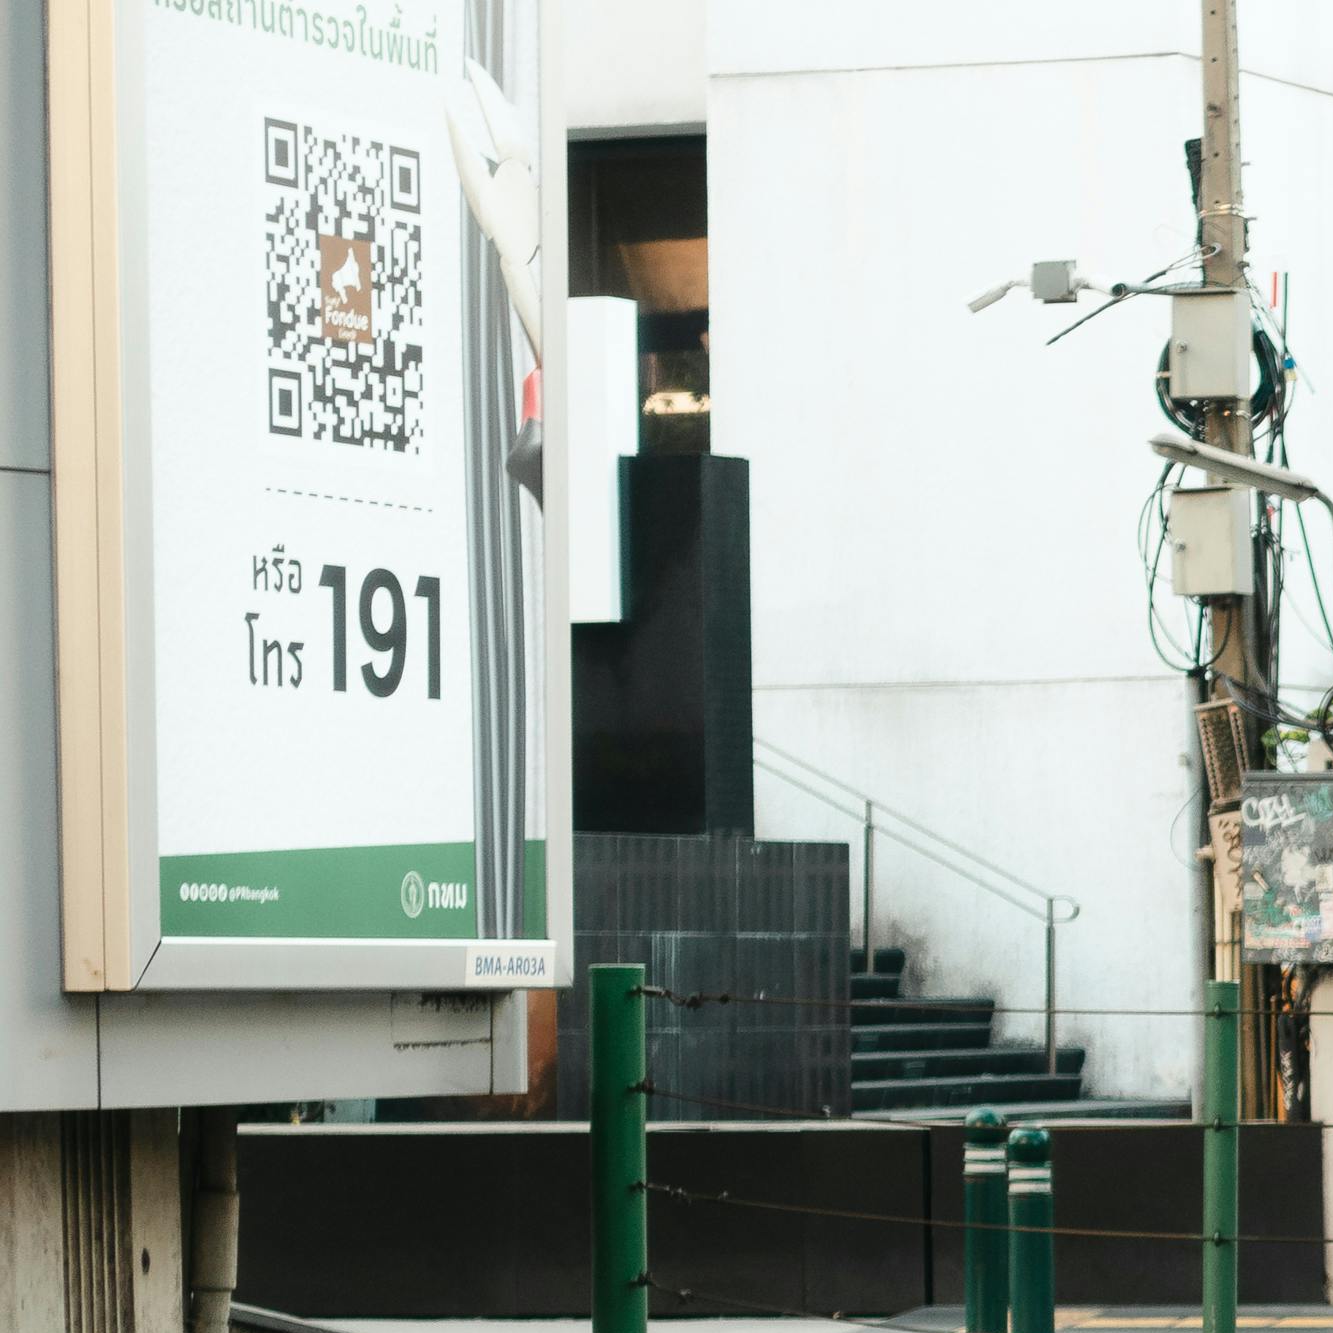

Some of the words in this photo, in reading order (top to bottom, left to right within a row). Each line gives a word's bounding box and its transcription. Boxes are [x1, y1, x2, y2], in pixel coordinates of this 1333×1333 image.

[325, 305, 369, 331] Fondue
[253, 543, 302, 594] หรือ
[244, 612, 305, 689] โทร
[318, 563, 441, 700] 191
[428, 881, 468, 909] กทม
[475, 955, 546, 977] BMA-AR03A
